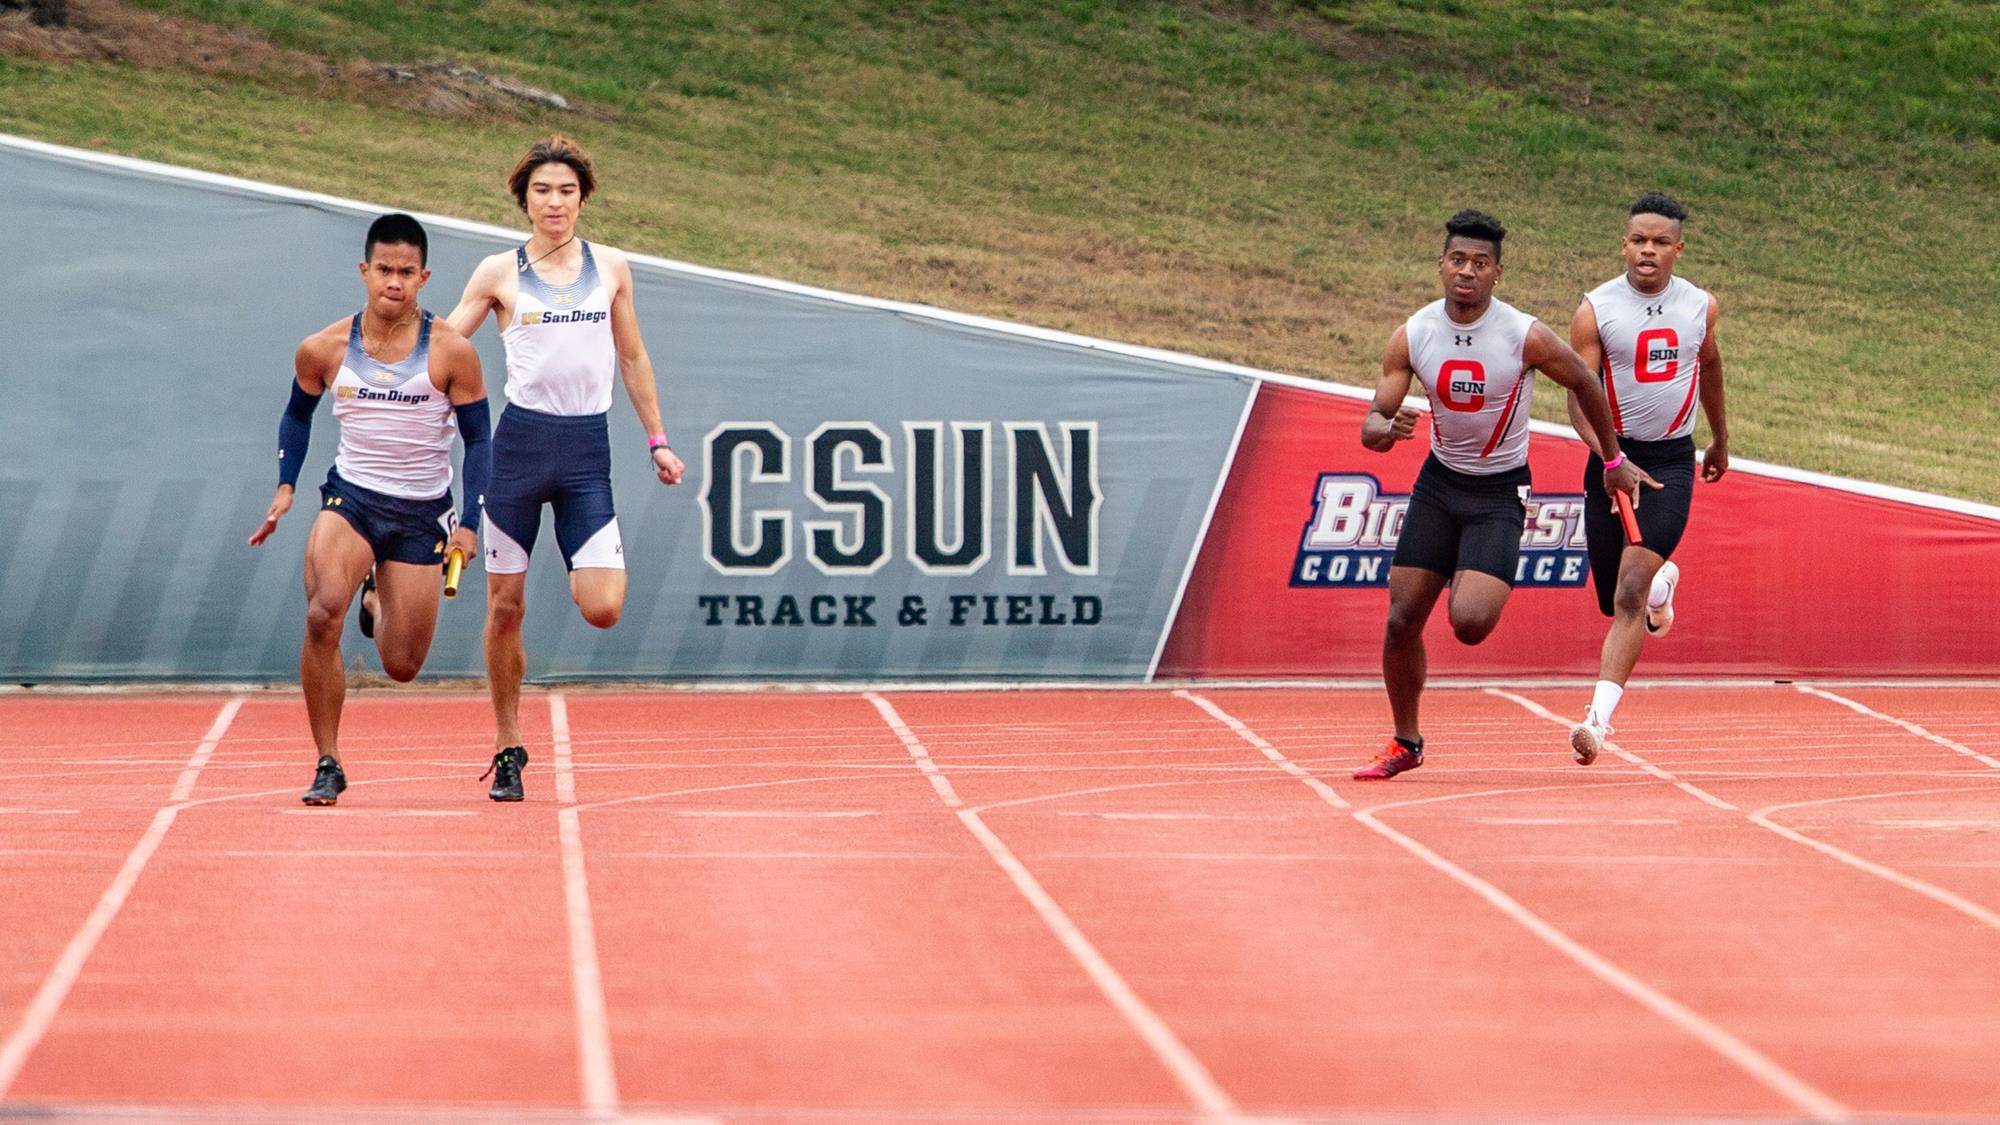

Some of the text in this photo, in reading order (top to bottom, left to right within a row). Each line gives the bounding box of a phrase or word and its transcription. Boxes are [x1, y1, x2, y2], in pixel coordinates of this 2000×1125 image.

[698, 420, 1105, 577] CSUN
[699, 595, 1103, 627] TRACK & FIELD
